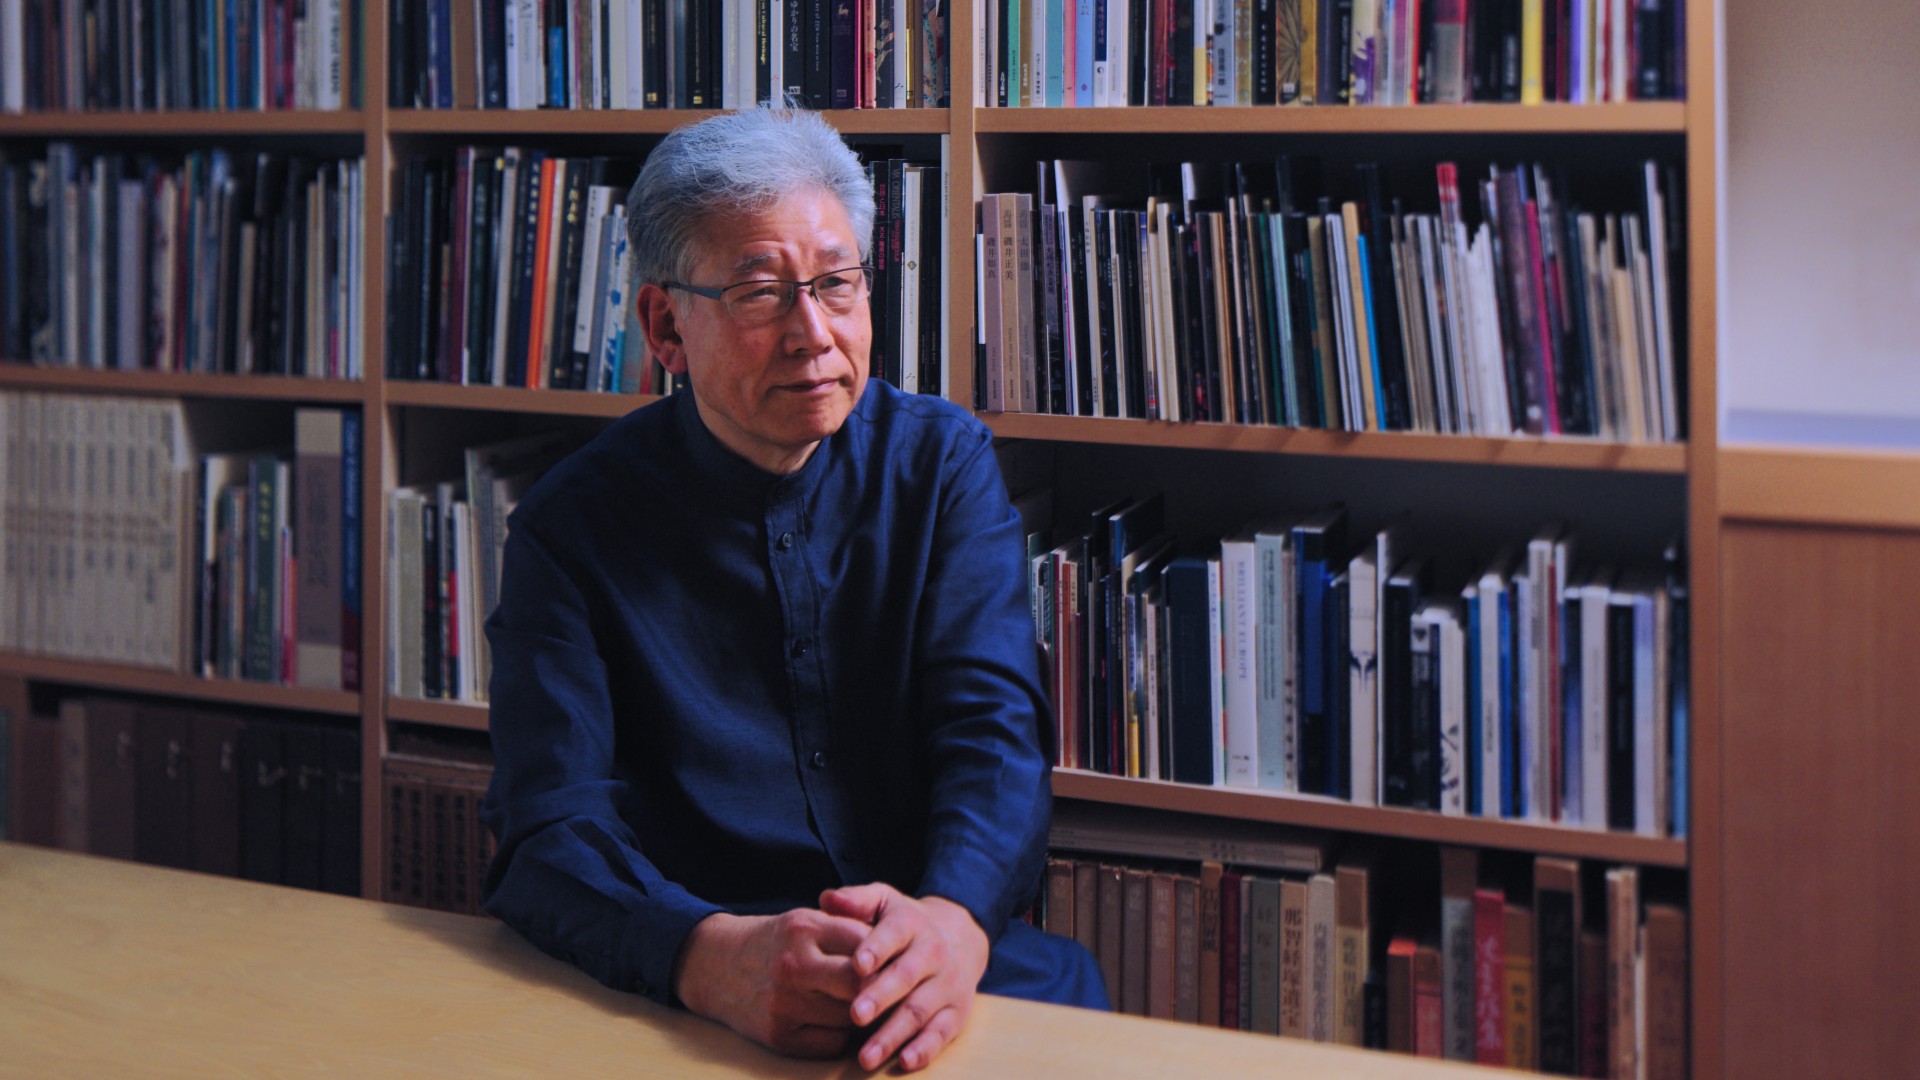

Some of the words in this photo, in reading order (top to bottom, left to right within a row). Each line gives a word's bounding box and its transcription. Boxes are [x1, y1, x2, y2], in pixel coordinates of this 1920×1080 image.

[891, 180, 902, 219] ORIENTALIS
[986, 237, 996, 280] 磯井如真
[1003, 236, 1014, 280] 磯井正美
[1238, 561, 1246, 626] BRILLIANT
[1239, 631, 1247, 680] EUROPE
